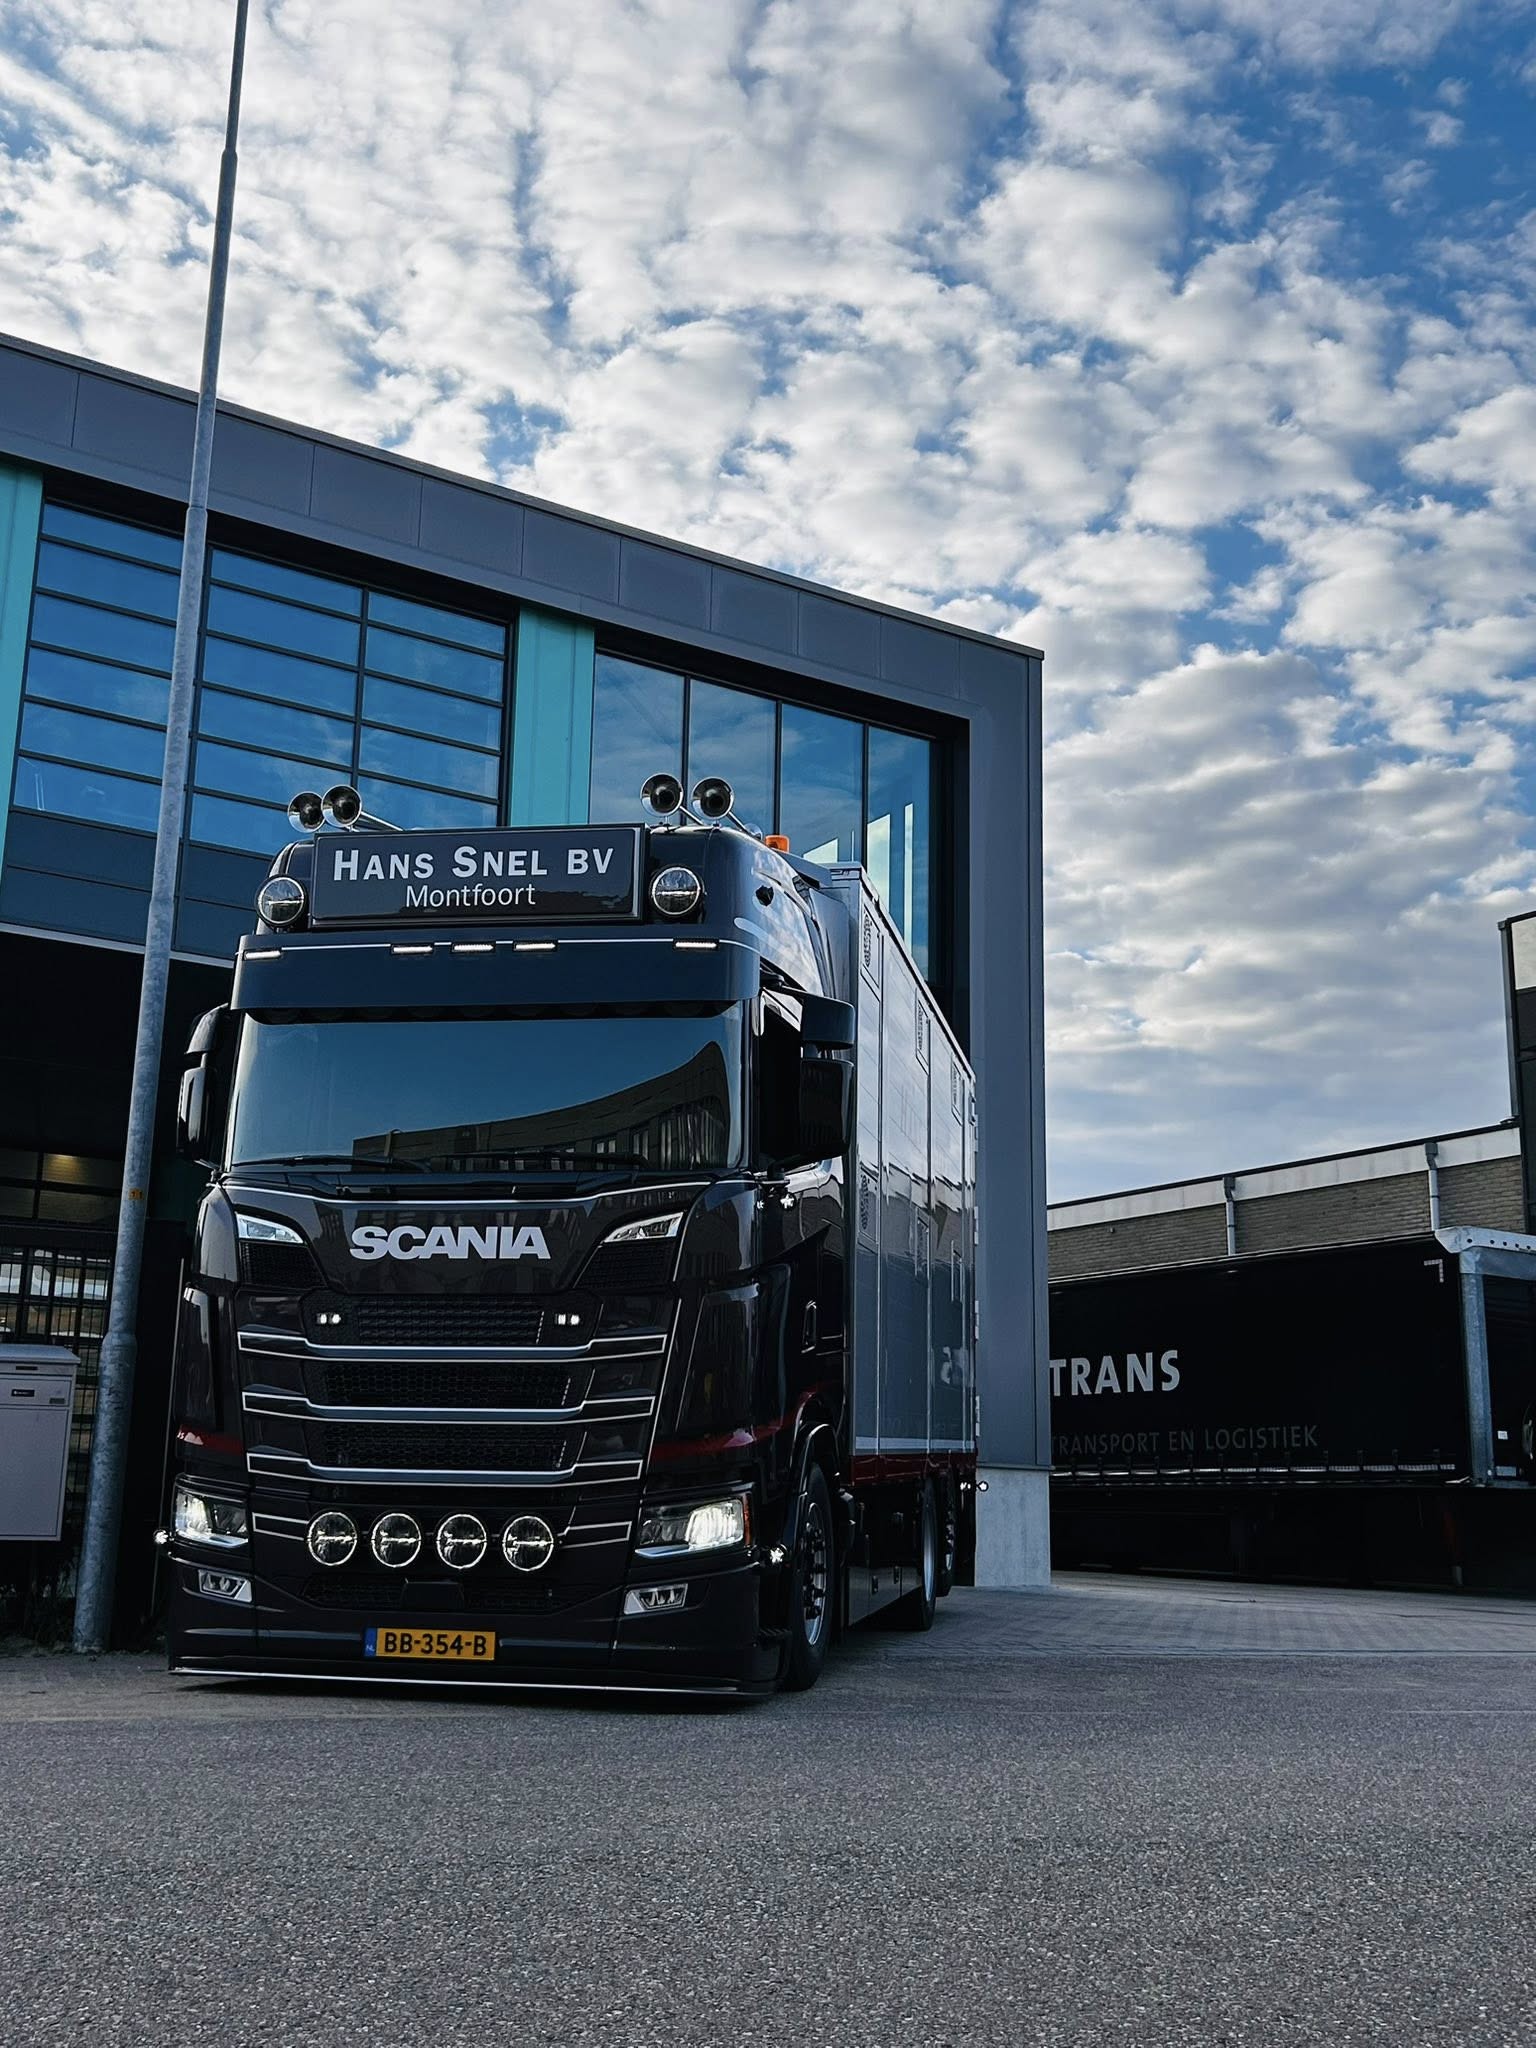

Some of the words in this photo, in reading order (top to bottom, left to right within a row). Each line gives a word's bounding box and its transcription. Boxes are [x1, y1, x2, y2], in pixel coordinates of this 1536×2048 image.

[333, 849, 434, 881] HANS
[452, 846, 548, 878] SNEL
[567, 848, 614, 875] BV
[406, 883, 536, 908] Montfoort
[350, 1226, 551, 1260] SCANIA
[1050, 1350, 1181, 1397] TRANS
[1169, 1429, 1195, 1452] EN
[1205, 1425, 1319, 1450] LOGISTIEK
[384, 1632, 487, 1656] BB-354-B
